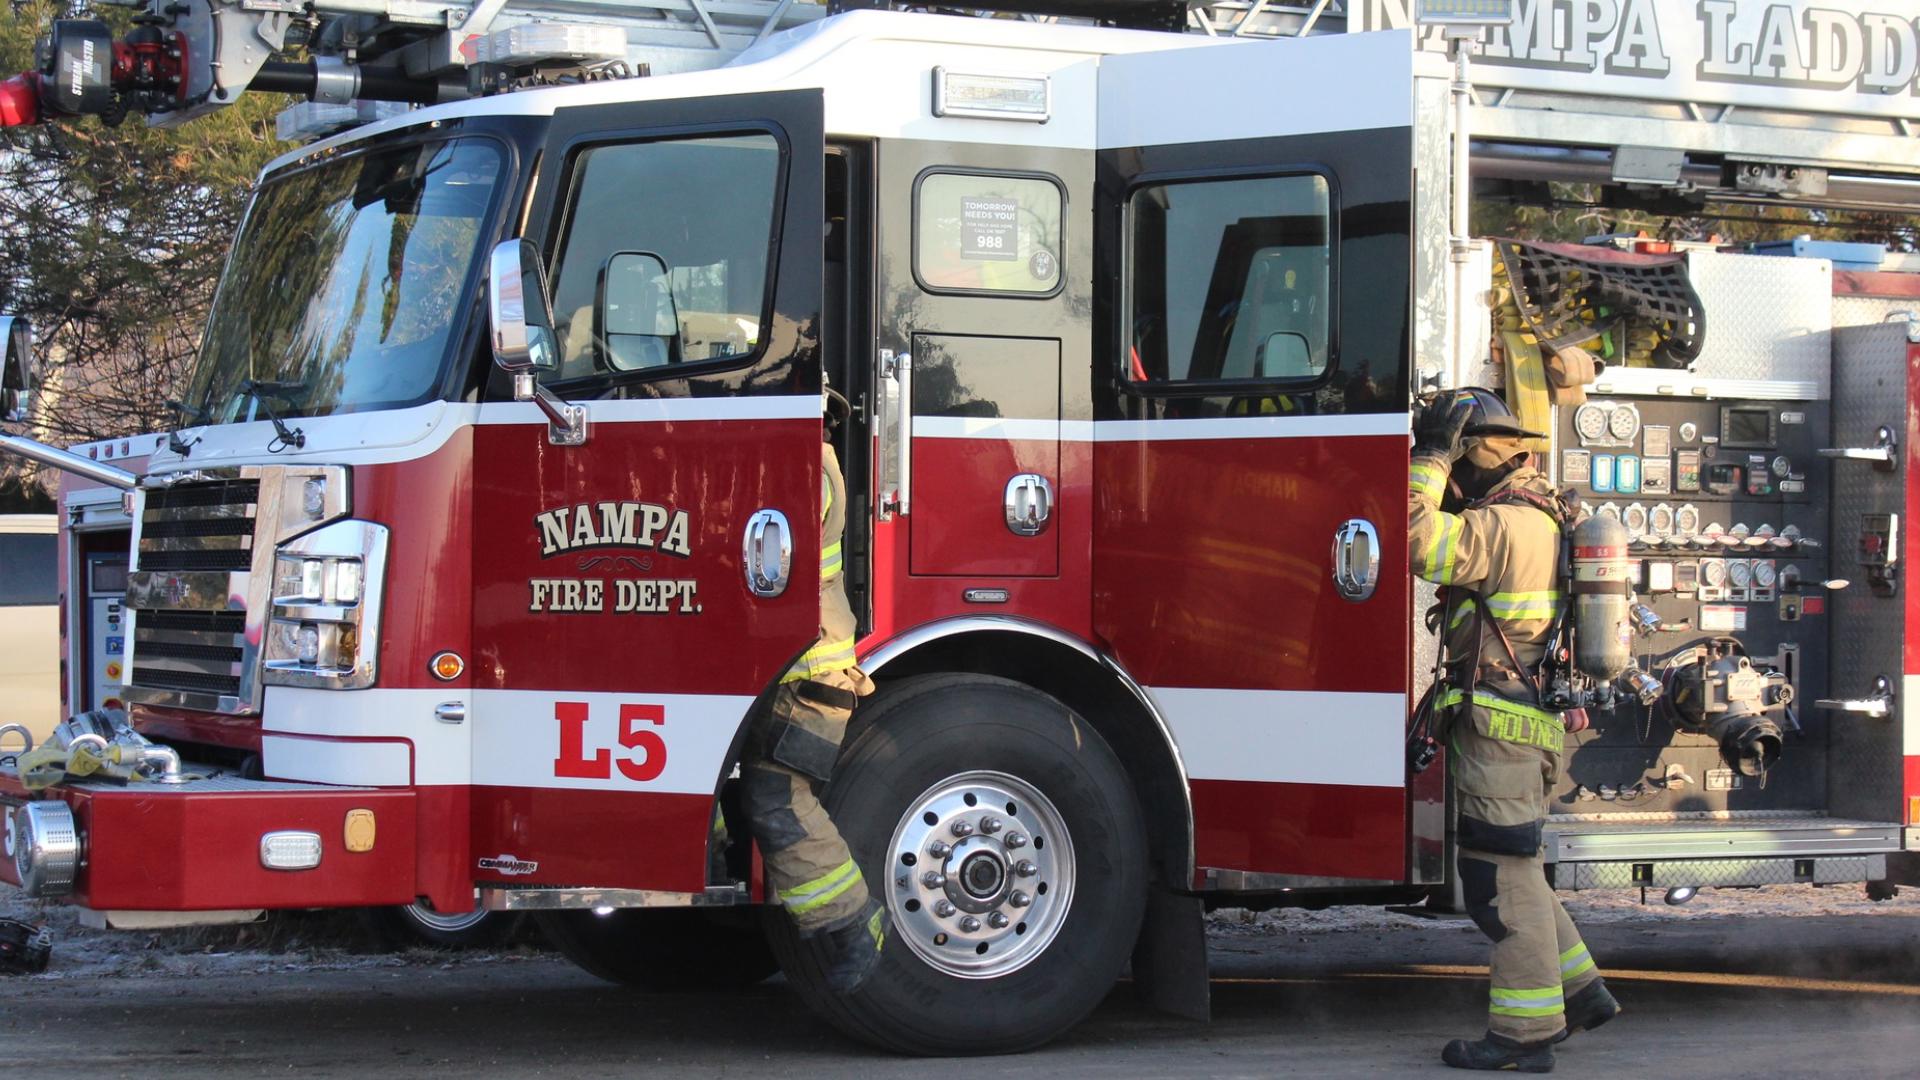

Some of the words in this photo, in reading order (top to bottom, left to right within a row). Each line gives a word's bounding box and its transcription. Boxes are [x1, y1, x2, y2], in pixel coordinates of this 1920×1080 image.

[83, 39, 94, 75] MASTER
[1696, 0, 1920, 97] LADD
[72, 60, 83, 96] STREAM
[965, 202, 1015, 211] TOMORROW
[965, 211, 993, 219] NEEDS
[994, 212, 1015, 221] YOU!
[977, 236, 1003, 248] 988
[536, 501, 692, 559] NAMPA
[529, 577, 604, 613] FIRE
[613, 578, 703, 614] DEPT.
[554, 702, 667, 781] L5
[5, 806, 16, 856] 5
